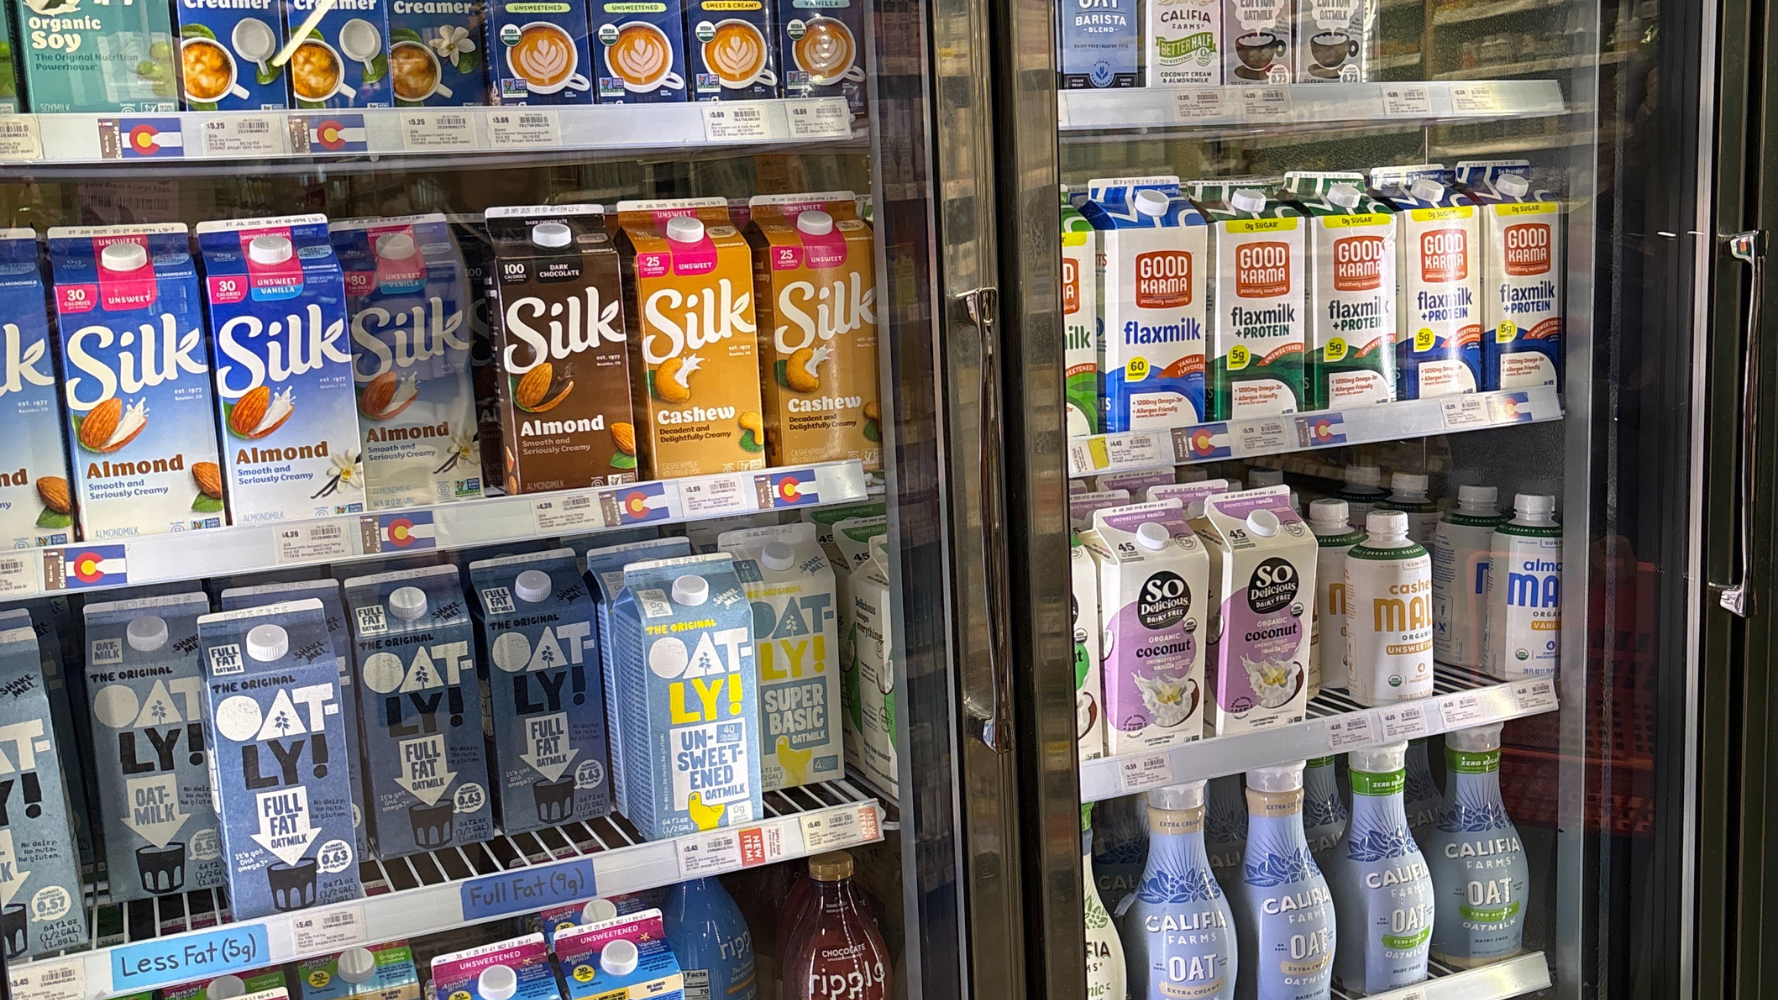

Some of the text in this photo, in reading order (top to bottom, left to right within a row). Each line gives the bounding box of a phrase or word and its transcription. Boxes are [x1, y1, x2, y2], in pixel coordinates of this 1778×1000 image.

[393, 1, 472, 14] Creamer
[1244, 10, 1273, 21] OATMILK
[29, 15, 101, 33] Organic
[1075, 14, 1127, 27] BARISTA
[1160, 10, 1211, 24] CALIFIA
[31, 31, 82, 53] Soy
[35, 53, 139, 63] The Original Nutrition
[1270, 74, 1287, 83] 0.73
[40, 103, 71, 112] SOYMILK
[1245, 222, 1253, 230] 0g
[1508, 228, 1547, 248] GOOD
[646, 256, 660, 267] 25
[1240, 247, 1286, 267] GOOD
[1508, 247, 1547, 262] KARMA
[505, 263, 525, 275] 100
[539, 269, 580, 278] CHOCOLATE
[678, 262, 712, 271] UNSWEET
[1140, 256, 1188, 277] GOOD
[1240, 267, 1286, 284] KARMA
[260, 286, 295, 294] VANILLA
[1141, 277, 1187, 294] KARMA
[1500, 281, 1555, 302] flaxmilk
[67, 289, 86, 301] 30
[108, 295, 151, 304] UNSWEET
[1140, 296, 1189, 306] positively nourishing
[775, 272, 876, 356] Silk
[1231, 303, 1295, 326] flaxmilk
[1503, 300, 1550, 314] +PROTEIN
[642, 278, 756, 366] Silk
[1124, 317, 1202, 345] flaxmilk
[351, 297, 470, 383] Silk
[503, 287, 627, 376] Silk
[1235, 324, 1290, 339] +PROTEIN
[217, 304, 351, 398] Silk
[1232, 349, 1244, 361] 5g
[1264, 343, 1302, 364] UNSWEETENED
[66, 313, 210, 411] Silk
[1131, 361, 1145, 372] 60
[1177, 357, 1200, 368] VANILLA
[1177, 363, 1204, 376] FLAVORED
[788, 395, 861, 412] Cashew
[1136, 406, 1178, 415] Allergen Friendly
[1137, 398, 1156, 407] 1200mg
[657, 405, 735, 425] Cashew
[520, 415, 605, 438] Almond
[659, 424, 710, 435] Decadent and
[522, 437, 570, 448] Smooth and
[660, 429, 731, 443] Delightfully Creamy
[236, 441, 328, 464] Almond
[523, 443, 591, 455] Seriously Creamy
[87, 454, 184, 479] Almond
[88, 479, 145, 491] Smooth and
[90, 486, 169, 500] Seriously Creamy
[95, 527, 140, 539] ALMONDMILK
[1229, 529, 1246, 539] 45
[1255, 565, 1293, 588] SO
[712, 587, 740, 605] SHAKE
[1145, 579, 1184, 602] SO
[725, 594, 744, 610] ME!
[1255, 593, 1291, 609] DAIRY FREE
[646, 618, 717, 636] THE ORIGINAL
[1257, 617, 1287, 627] ORGANIC
[1148, 633, 1181, 643] ORGANIC
[1245, 623, 1298, 642] coconut
[649, 627, 752, 679] OAT-
[1136, 639, 1191, 658] coconut
[759, 636, 825, 681] LY!
[90, 666, 173, 683] THE ORIGINAL
[212, 675, 296, 694] THE ORIGINAL
[669, 673, 743, 725] LY!
[764, 684, 824, 713] SUPER
[216, 682, 339, 742] OAT-
[769, 705, 824, 736] BASIC
[531, 717, 564, 740] FULL
[792, 730, 826, 745] OATMILK
[536, 736, 562, 757] FAT
[681, 727, 714, 752] UN-
[242, 734, 329, 790] LY!
[536, 754, 568, 768] OATMILK
[677, 749, 743, 771] SWEET-
[690, 764, 734, 790] ENED
[136, 785, 170, 806] OAT-
[457, 793, 482, 805] 0.63
[705, 783, 745, 800] OATMILK
[264, 792, 303, 817] FULL
[135, 803, 175, 826] MILK
[270, 813, 299, 837] FAT
[271, 834, 308, 849] OATMILK
[743, 835, 754, 862] ITEM!
[752, 835, 763, 858] NEW
[1445, 837, 1521, 860] CALIFIA
[469, 867, 585, 907] Full Fat (9g)
[1468, 877, 1513, 906] OAT
[37, 897, 66, 913] 0.57
[1263, 887, 1331, 914] CALIFIA
[1146, 909, 1227, 933] CALIFIA
[1463, 918, 1517, 931] OATMILK
[580, 924, 639, 945] UNSWEETENED
[1169, 932, 1217, 945] FARMS
[822, 943, 867, 958] CHOCOLATE
[1291, 928, 1328, 960] OAT
[121, 933, 256, 977] Less Fat (5g)
[378, 952, 406, 962] Original
[459, 950, 521, 970] UNSWEETENED
[564, 949, 593, 963] Almond
[1169, 953, 1218, 982] OAT
[810, 961, 886, 1000] ripple
[1167, 983, 1220, 996] EXTRA CREAMY
